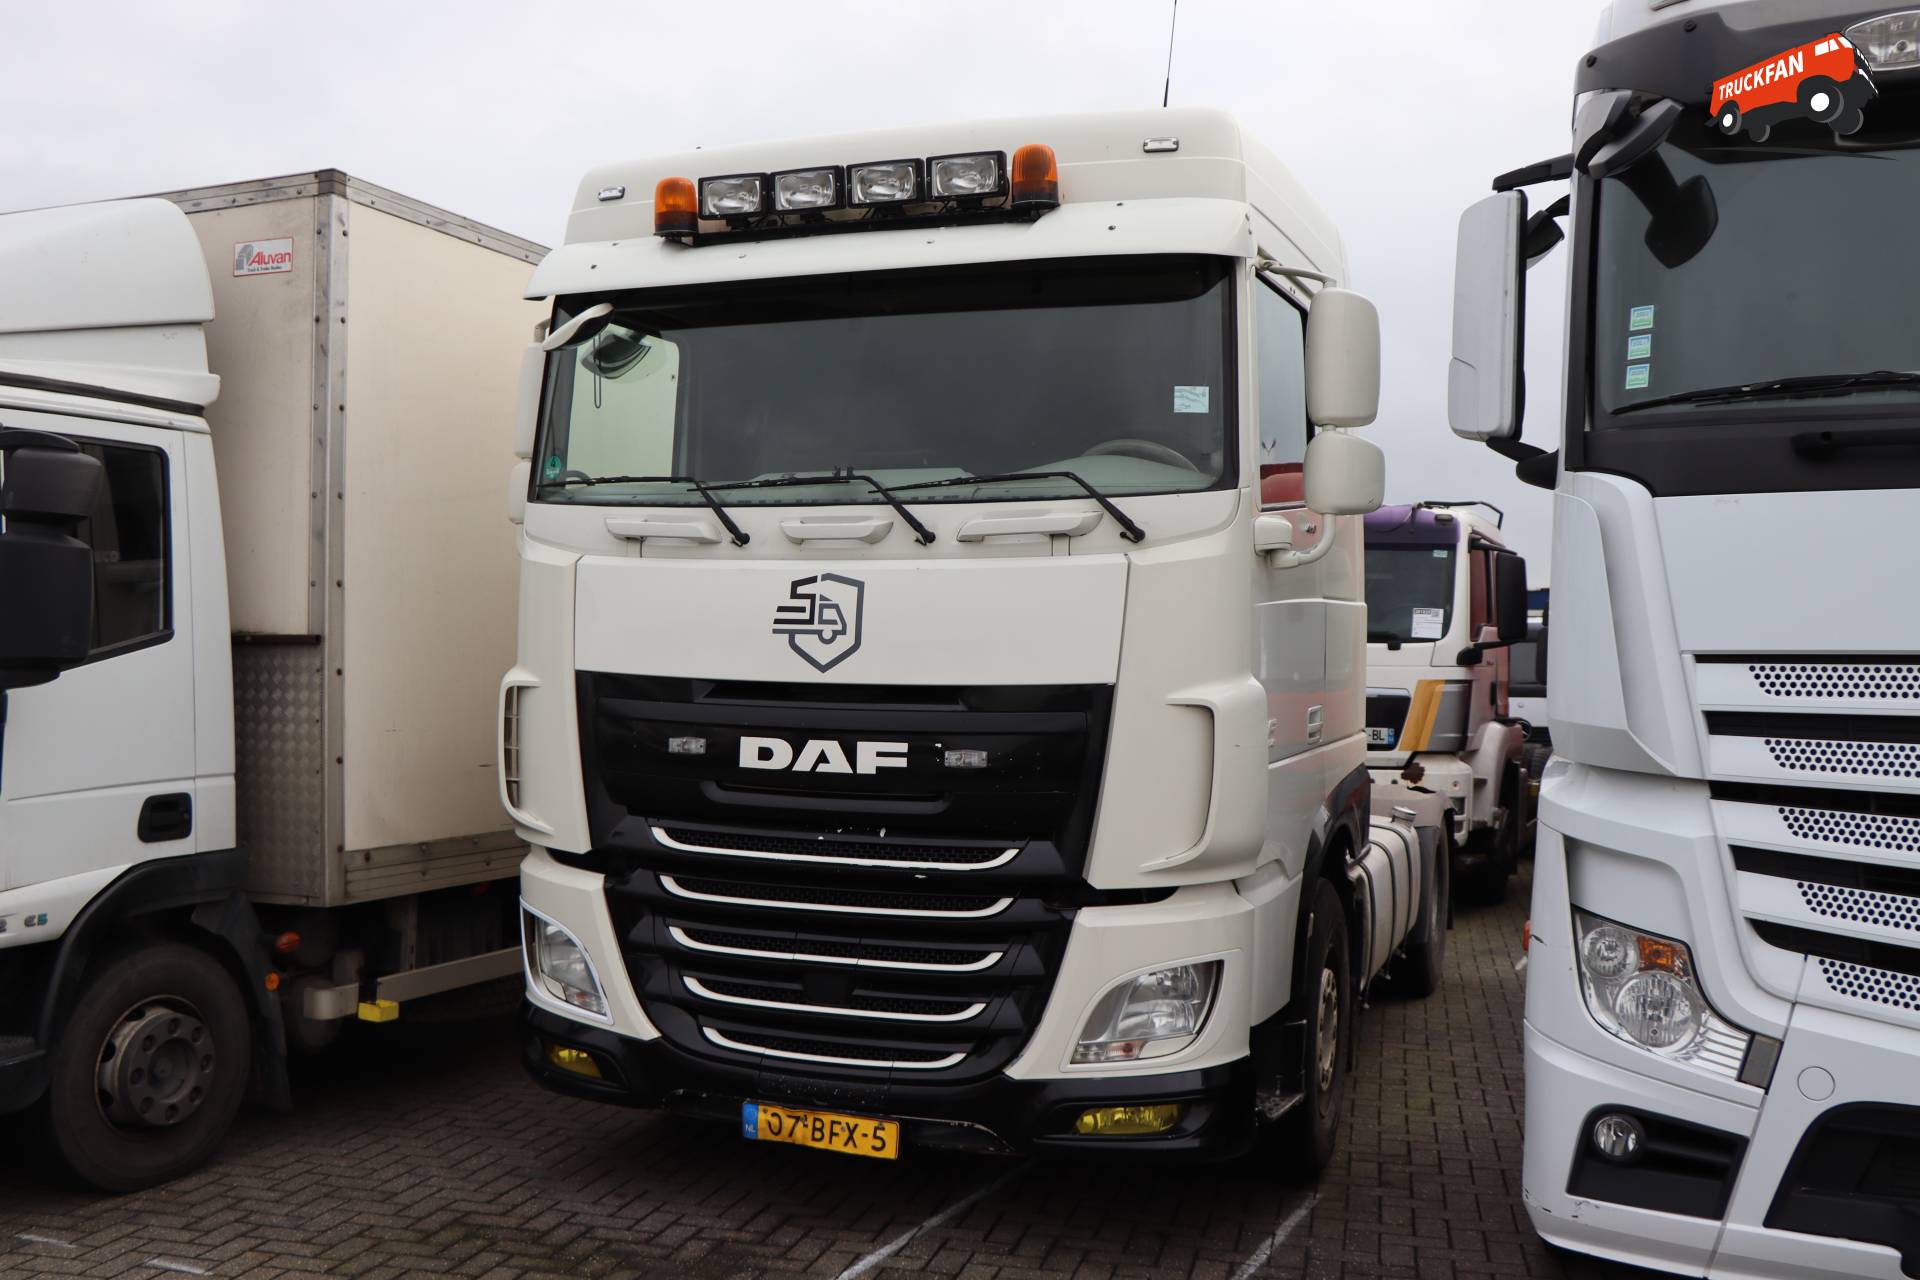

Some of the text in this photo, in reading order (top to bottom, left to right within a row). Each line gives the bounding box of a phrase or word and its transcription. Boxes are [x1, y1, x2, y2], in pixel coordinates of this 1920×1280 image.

[248, 251, 291, 266] Aluvan
[738, 735, 909, 774] DAF
[745, 1123, 756, 1132] NL
[767, 1112, 887, 1152] 07-BFX-5
